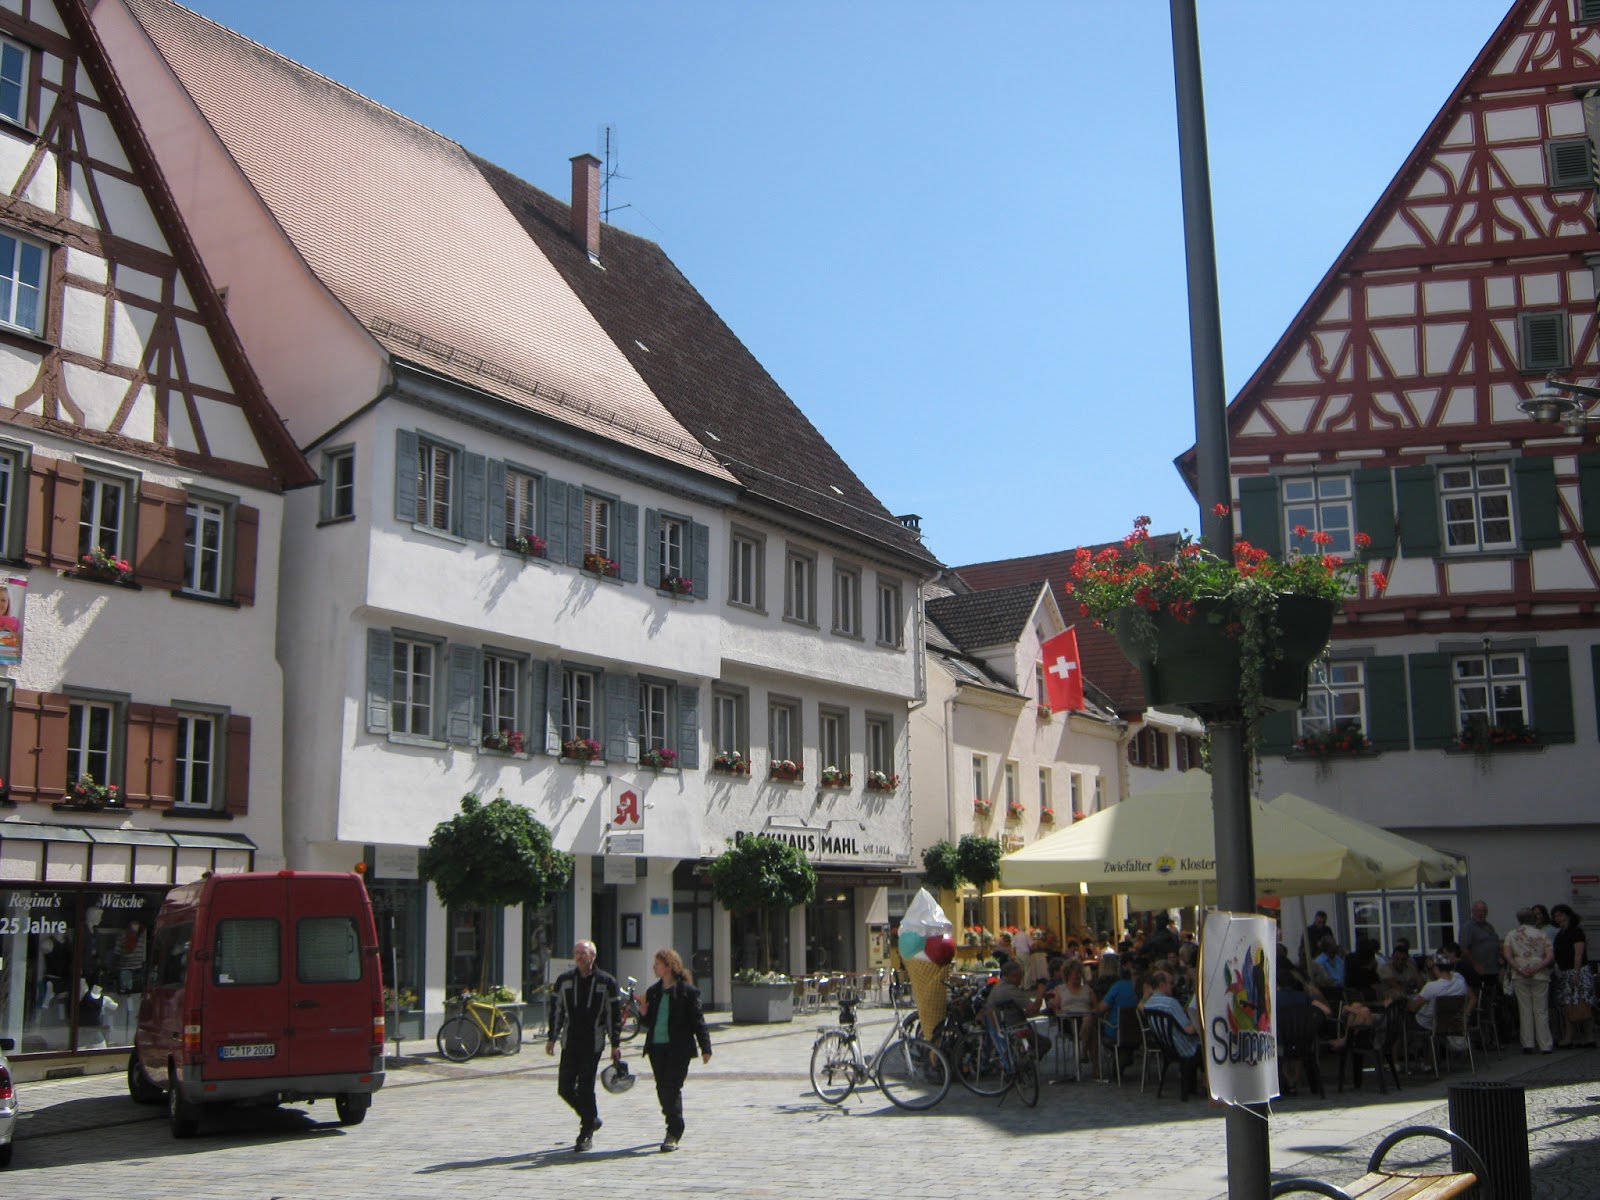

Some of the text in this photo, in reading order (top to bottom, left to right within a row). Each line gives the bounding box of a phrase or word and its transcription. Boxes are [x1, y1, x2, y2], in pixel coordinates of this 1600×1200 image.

[821, 836, 859, 855] MAHL
[1103, 858, 1152, 873] Zwiefalter
[9, 892, 144, 910] Regina's Wäsche
[0, 916, 67, 934] 25 Jahre
[224, 1045, 274, 1057] BC TP 2001
